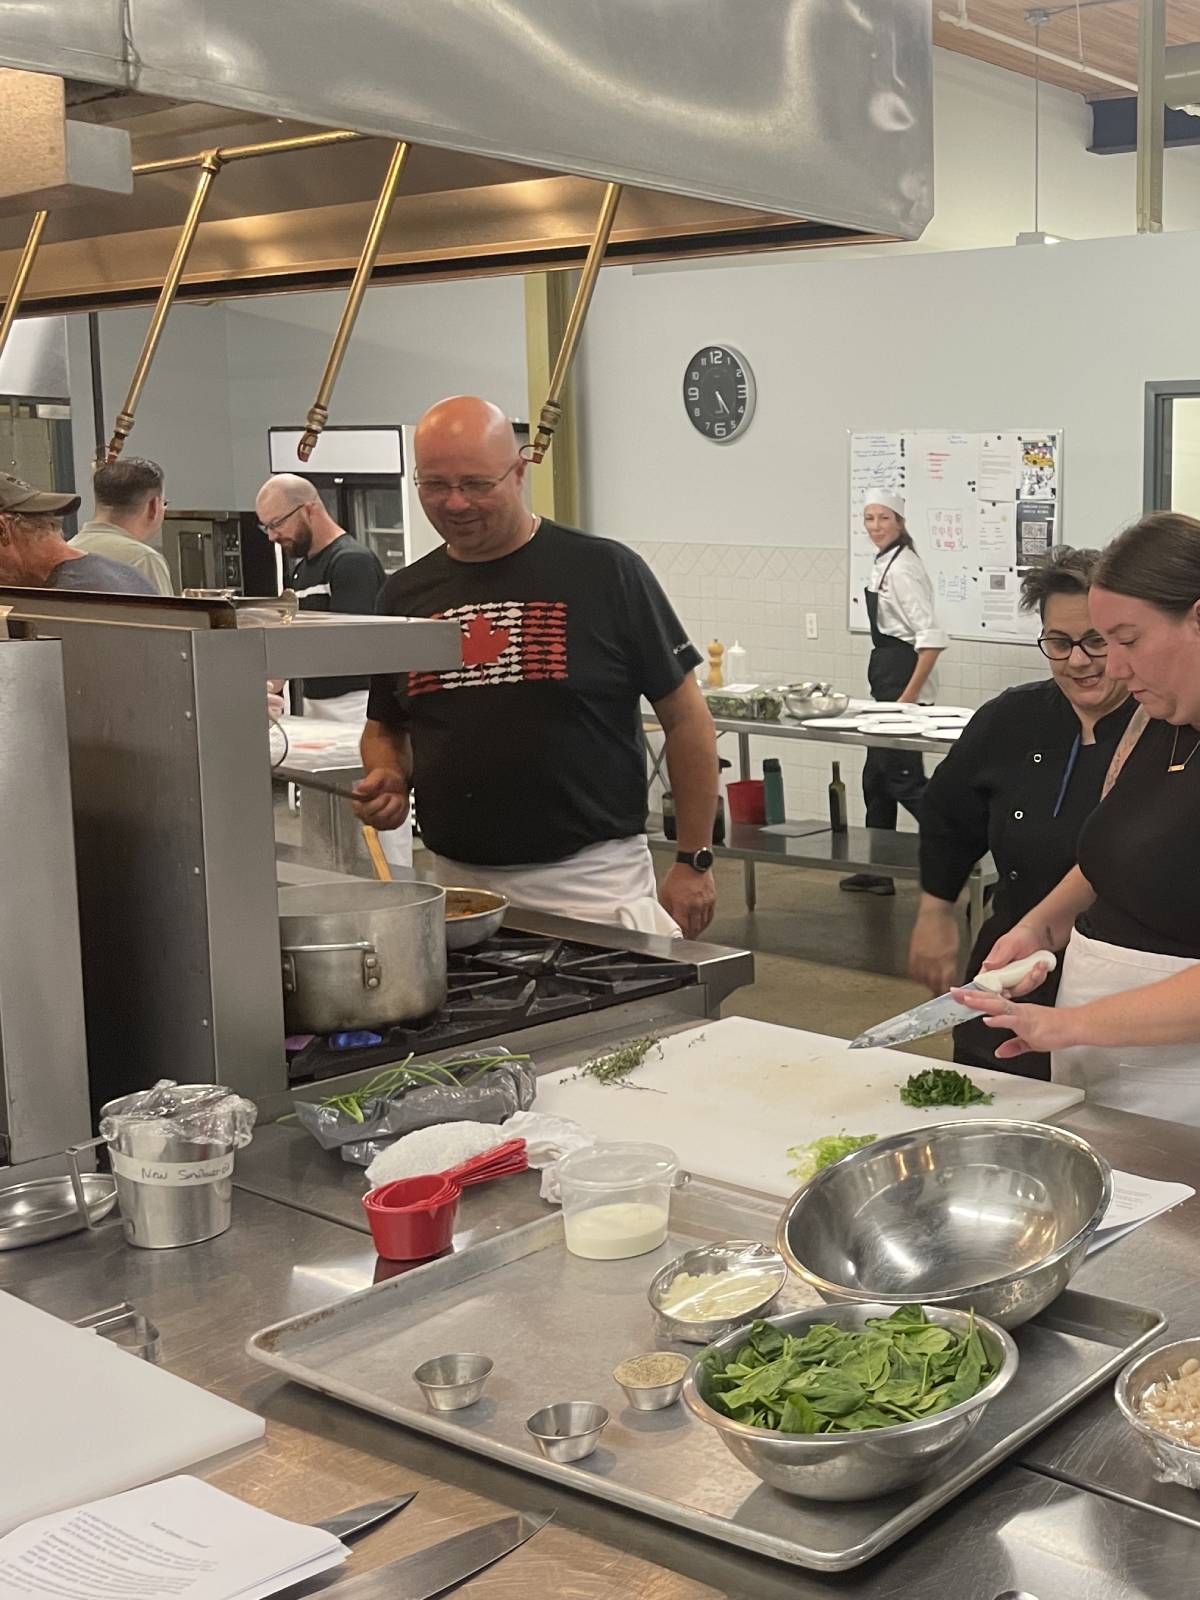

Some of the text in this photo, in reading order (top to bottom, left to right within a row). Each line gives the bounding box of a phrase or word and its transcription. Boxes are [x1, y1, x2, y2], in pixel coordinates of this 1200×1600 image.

[709, 351, 723, 364] 12
[692, 372, 699, 380] 10
[736, 369, 743, 378] 2
[688, 387, 699, 401] 9
[694, 408, 700, 416] 8
[705, 422, 711, 430] 7
[714, 422, 726, 436] 6
[730, 421, 737, 429] 5
